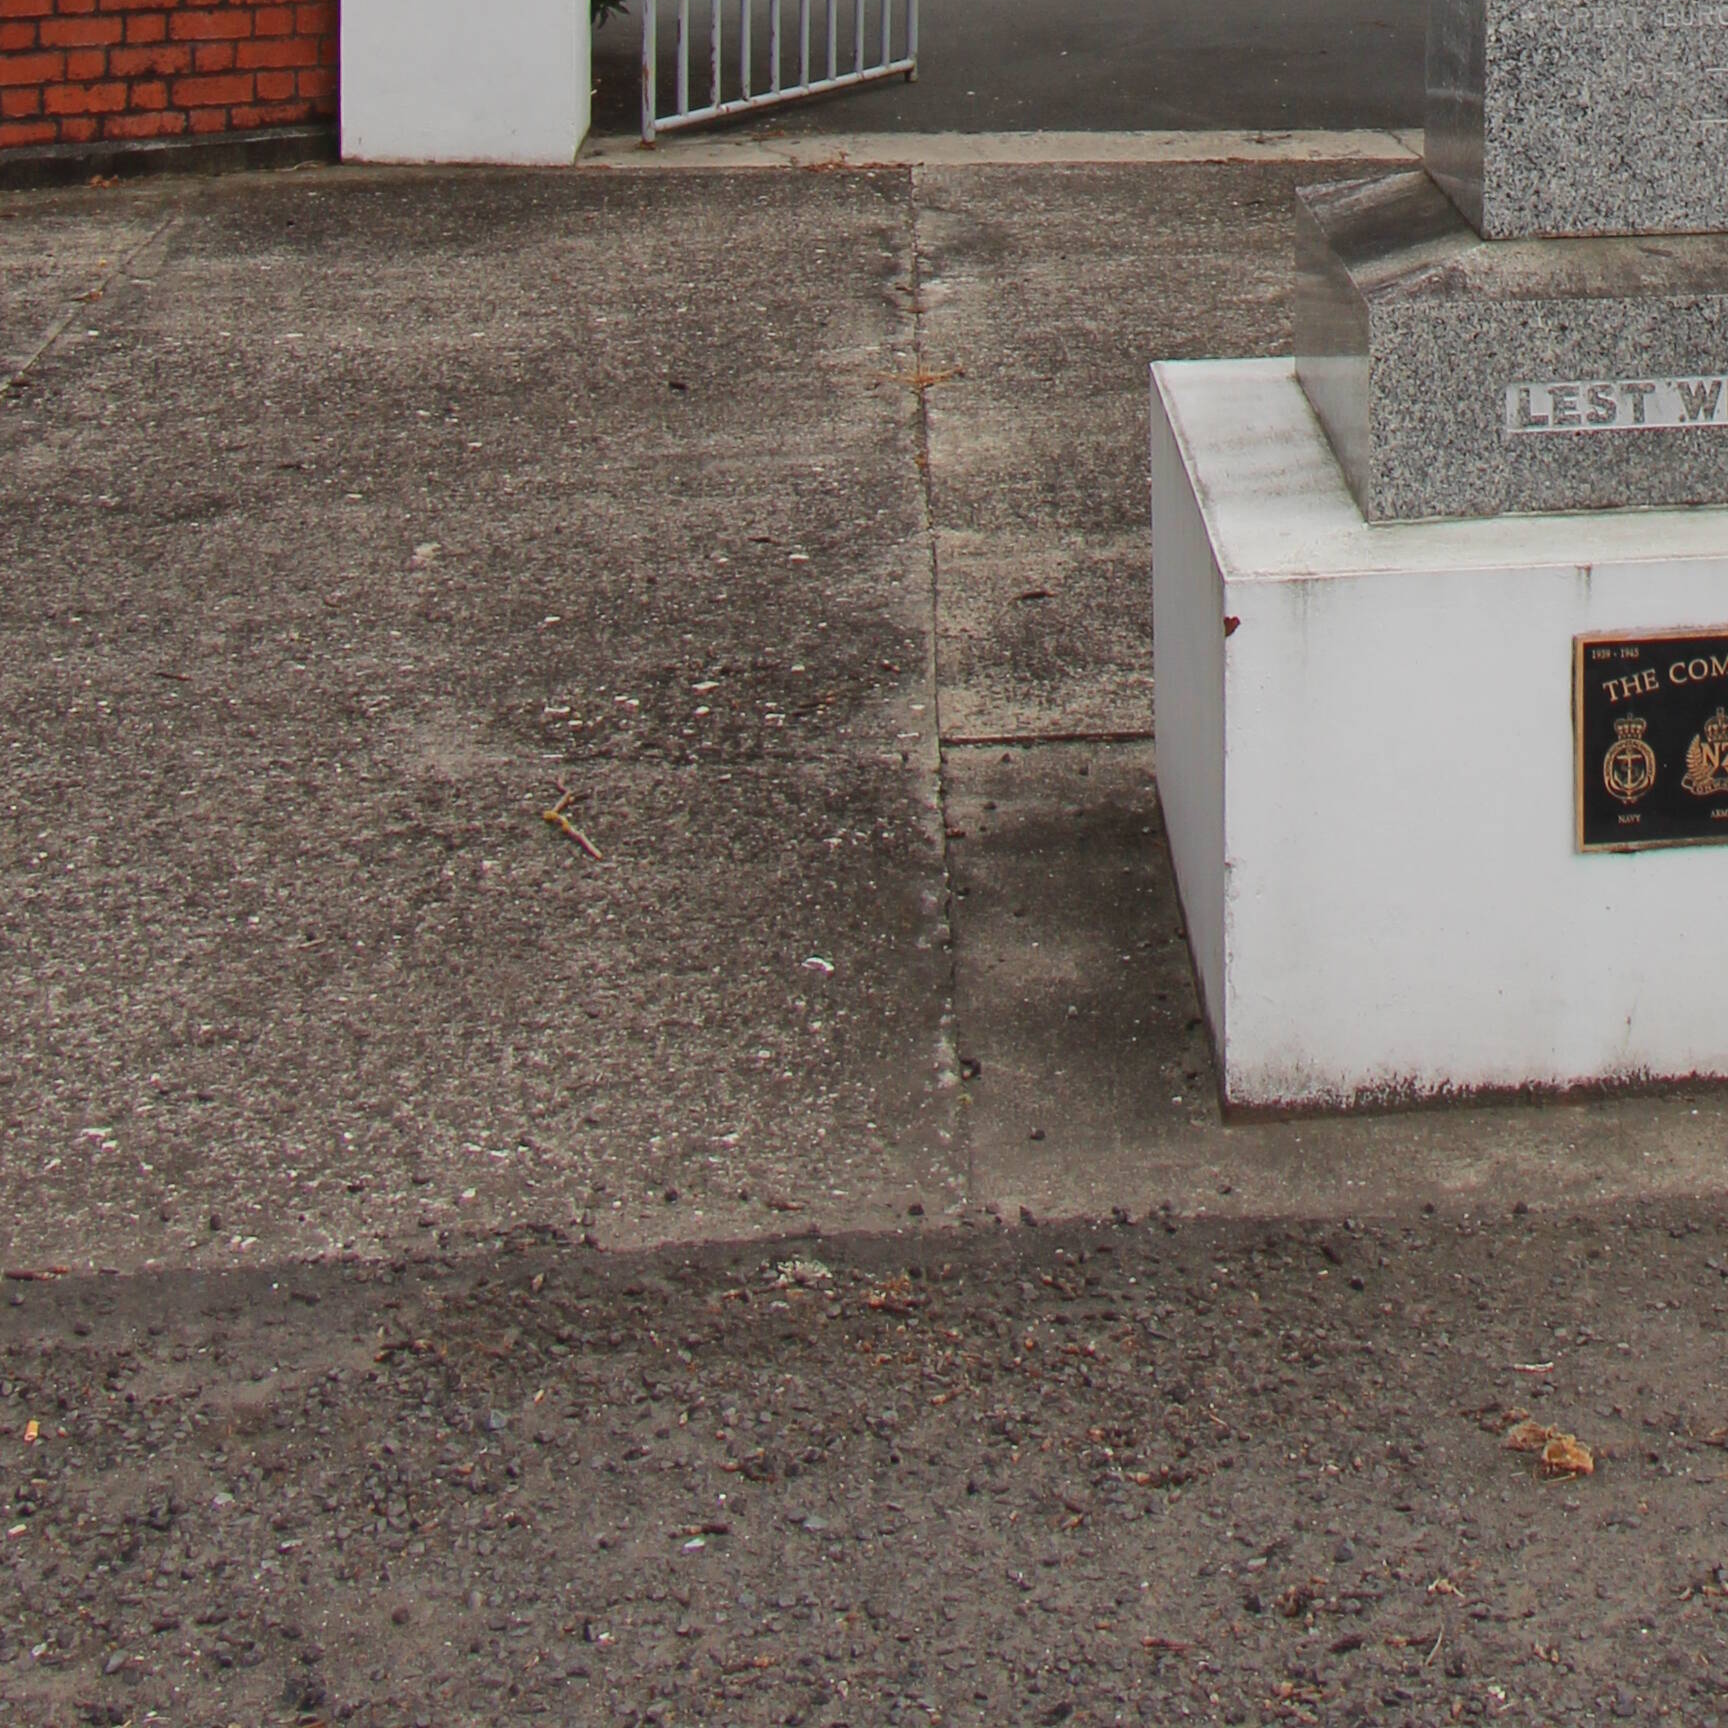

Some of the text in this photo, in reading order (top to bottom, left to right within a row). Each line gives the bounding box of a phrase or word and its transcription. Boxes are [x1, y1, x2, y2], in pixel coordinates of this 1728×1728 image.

[1517, 382, 1656, 426] LEST
[1602, 668, 1660, 703] THE
[1618, 814, 1641, 825] NAVY
